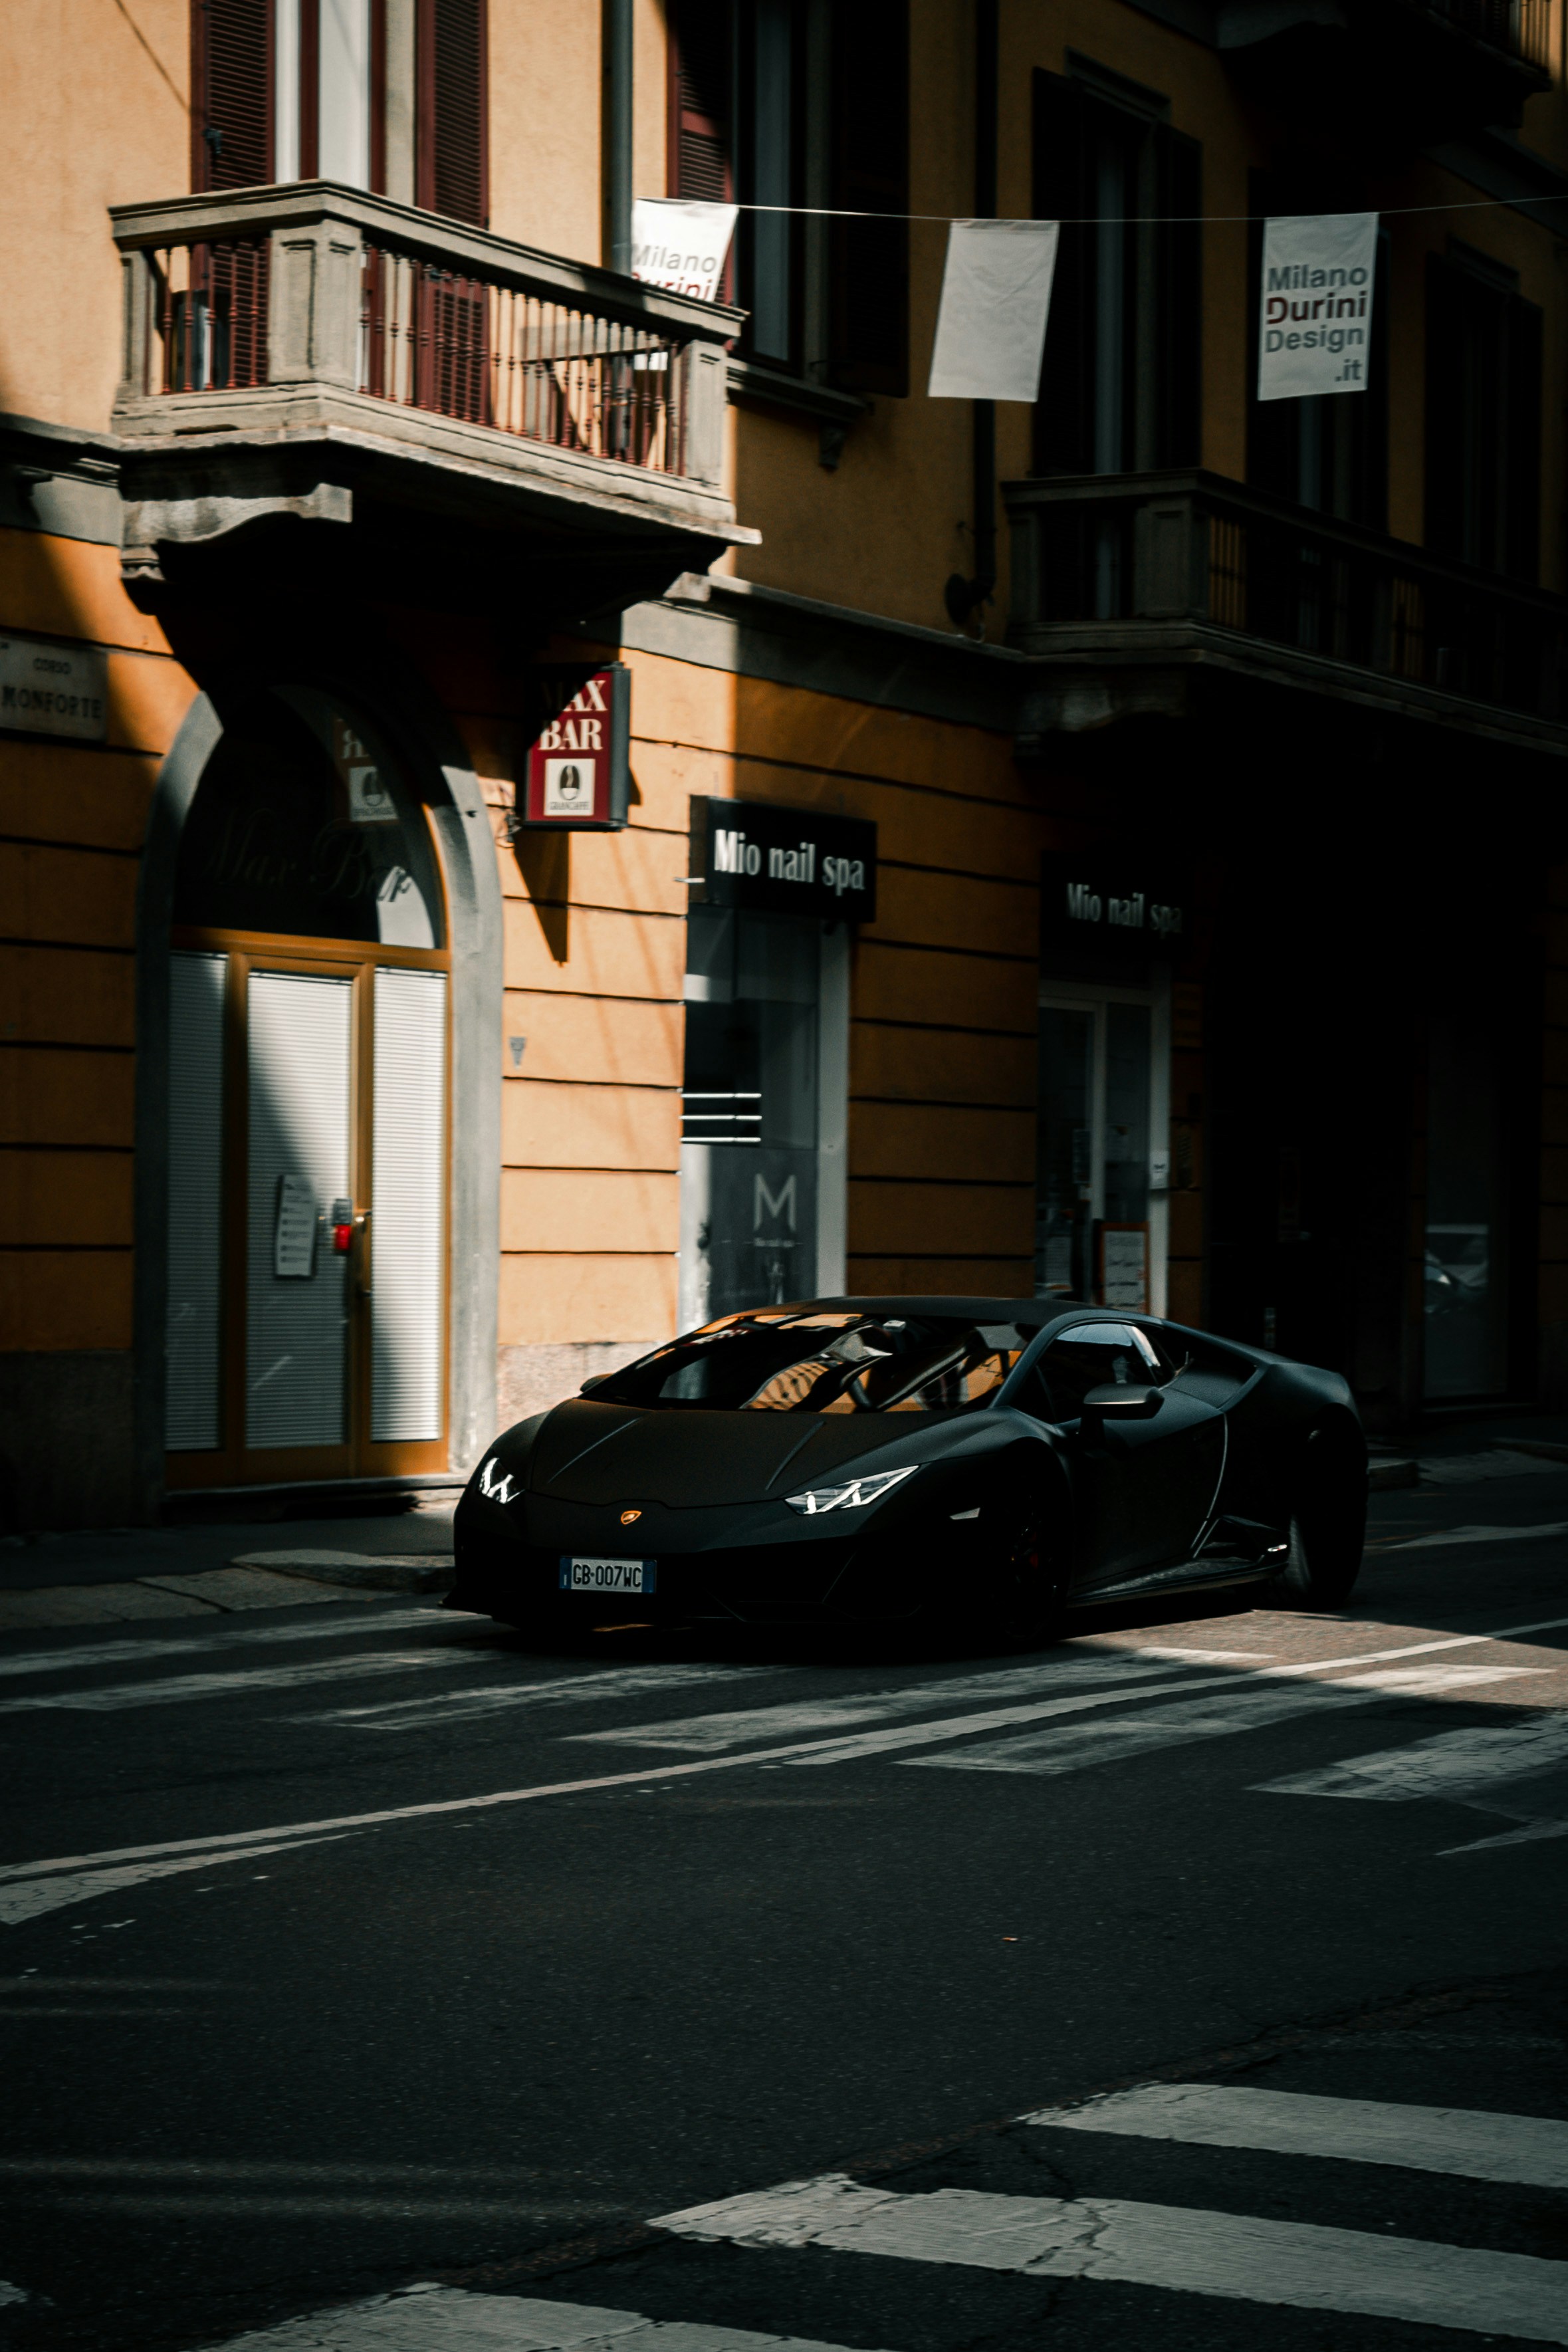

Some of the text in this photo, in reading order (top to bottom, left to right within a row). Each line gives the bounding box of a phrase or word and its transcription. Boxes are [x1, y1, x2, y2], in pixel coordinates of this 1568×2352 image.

[632, 243, 717, 273] Milano
[1268, 265, 1367, 291] Milano
[1267, 291, 1367, 324] Durini
[1266, 325, 1364, 353] Design
[1335, 359, 1361, 382] .it
[34, 657, 71, 675] CORSO
[2, 685, 101, 719] MONFORTE
[538, 679, 608, 711] MAX
[538, 718, 603, 751] BAR
[714, 829, 867, 897] Mio nail spa
[1065, 882, 1183, 940] Mio nail spa
[754, 1173, 796, 1232] M
